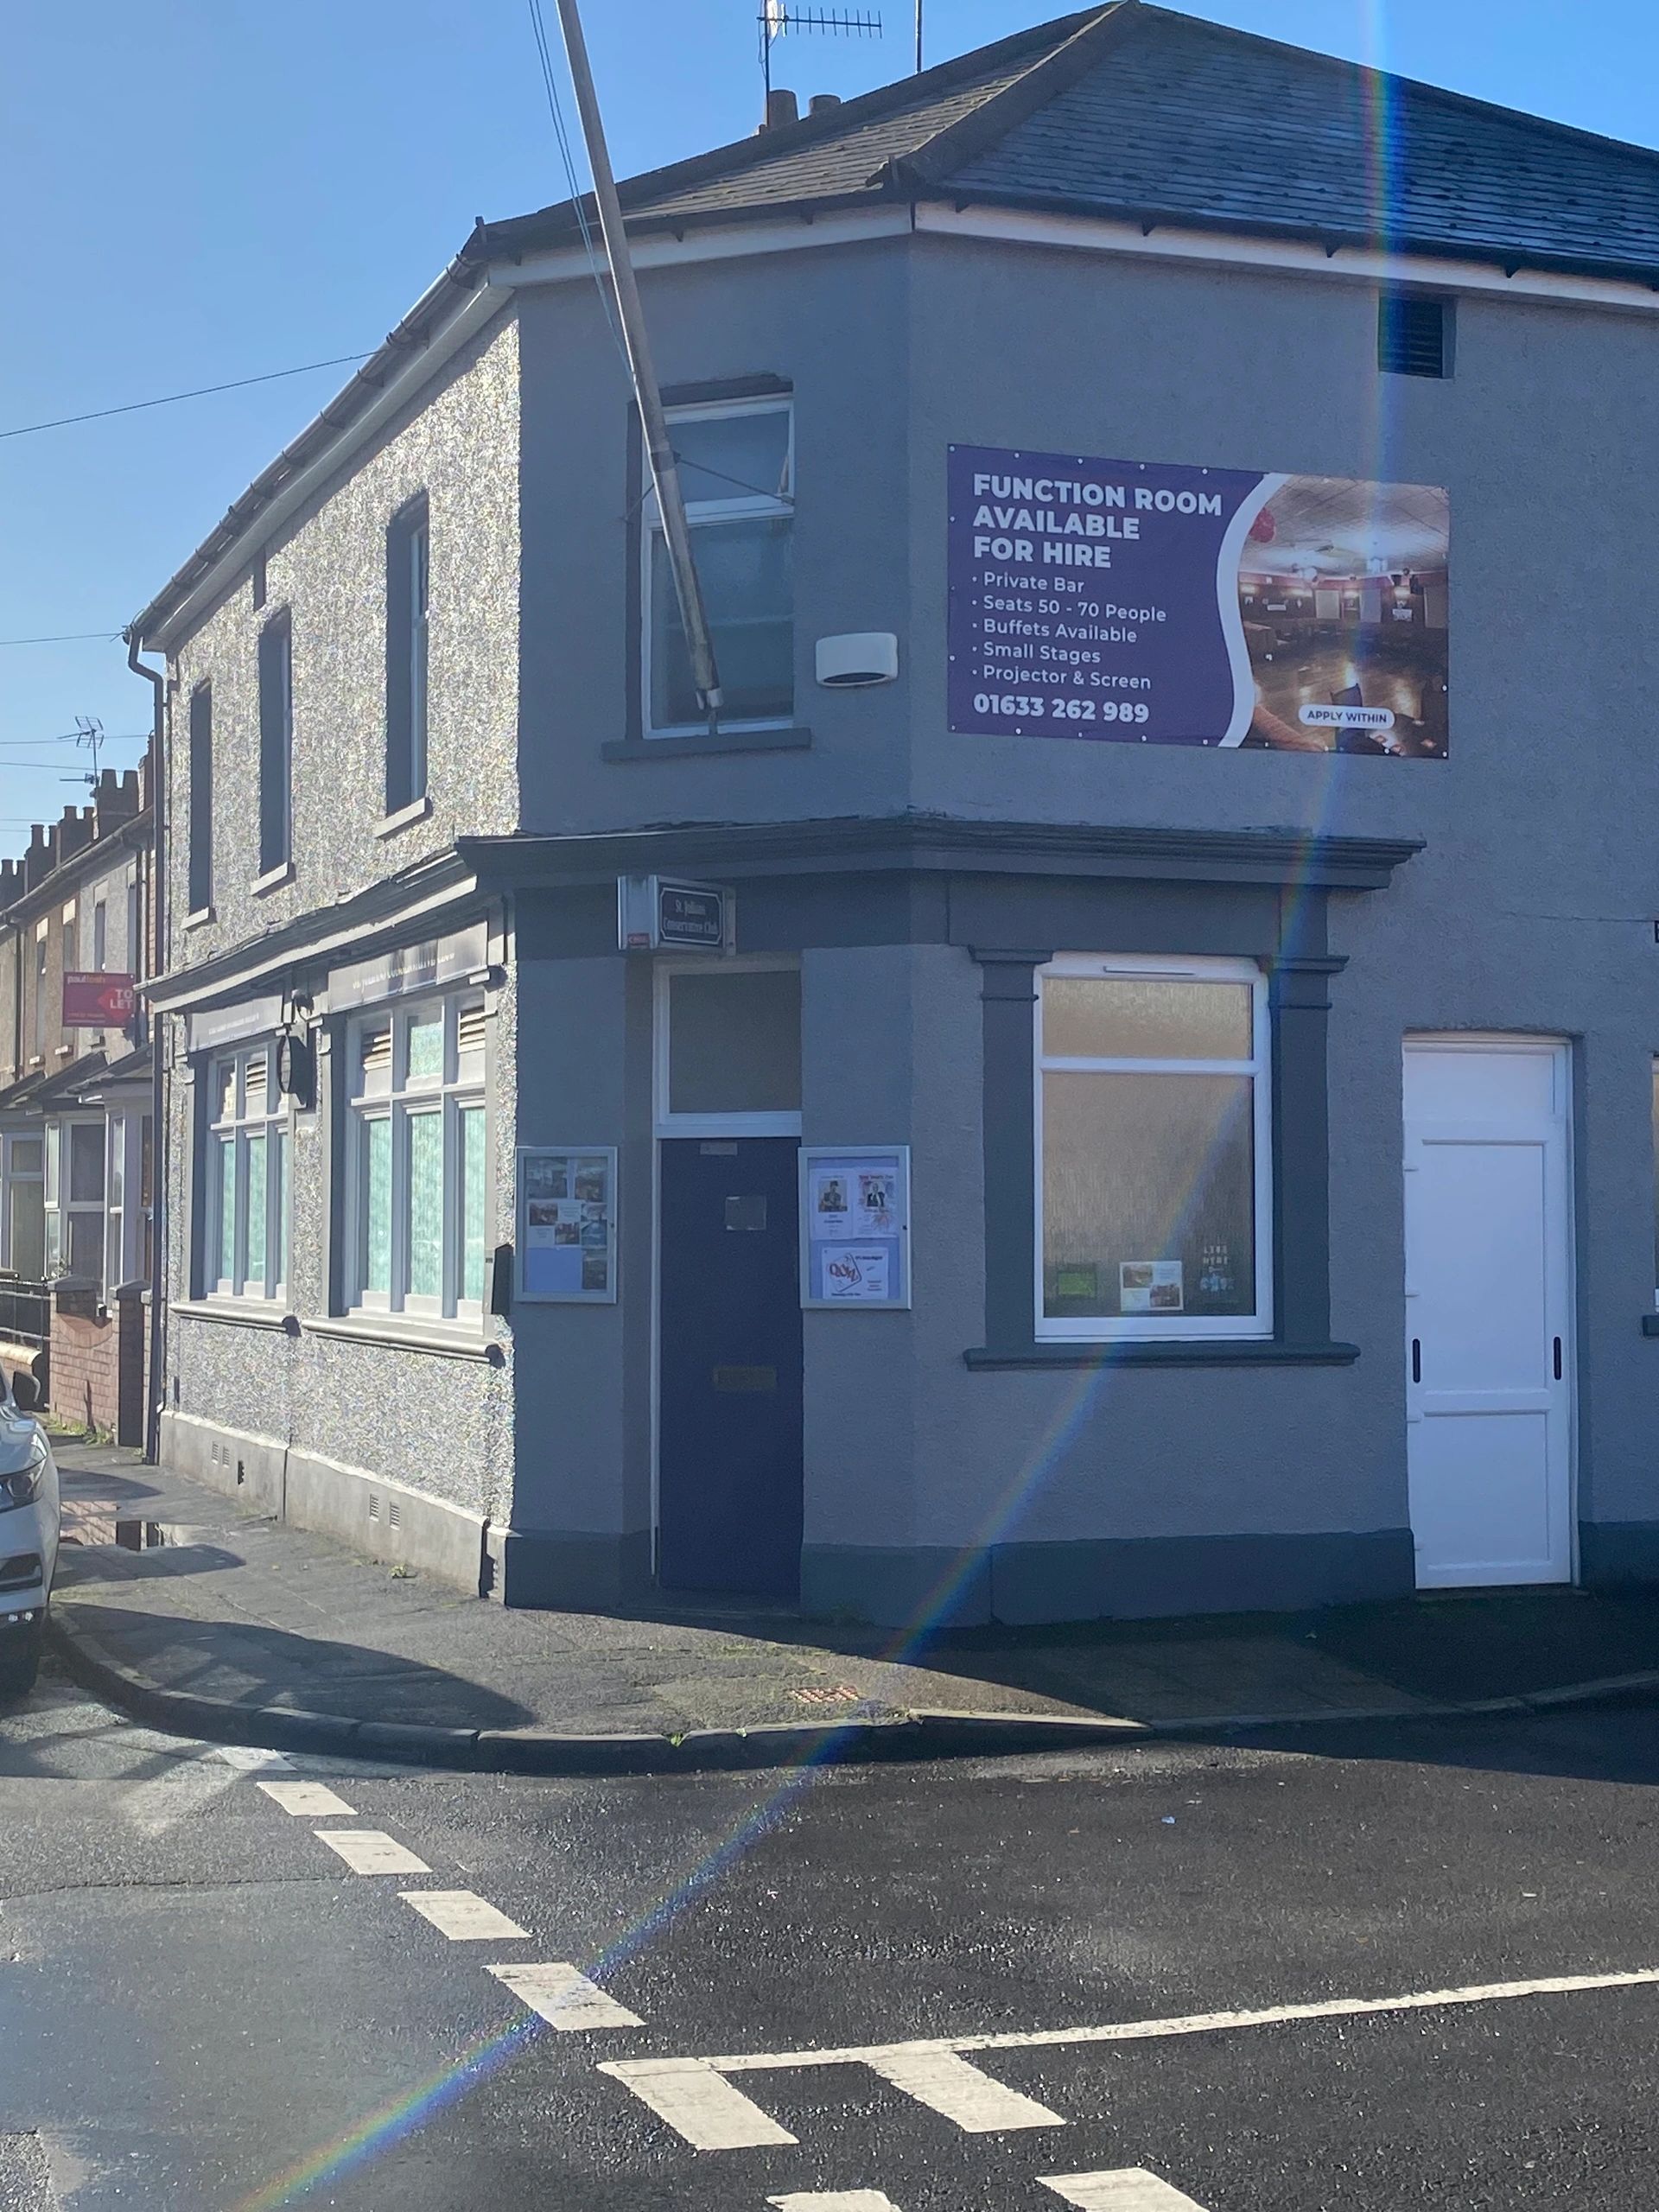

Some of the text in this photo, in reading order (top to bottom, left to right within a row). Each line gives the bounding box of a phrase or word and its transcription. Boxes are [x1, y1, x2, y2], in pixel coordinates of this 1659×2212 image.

[973, 474, 1222, 516] FUNCTION ROOM
[973, 505, 1141, 539] AVAILABLE
[973, 536, 1111, 569] FOR HIRE
[983, 571, 1084, 594] Private Bar
[983, 595, 1033, 613] Seats
[1039, 599, 1060, 614] 50
[1077, 601, 1099, 618] 70
[1105, 604, 1166, 624] People
[983, 619, 1137, 643] Buffets Available
[983, 642, 1101, 665] Small Stages
[983, 664, 1152, 690] Projector & Screen
[973, 693, 1150, 723] 01633 262 989
[1306, 709, 1388, 723] APPLY WITHIN
[110, 1000, 133, 1009] LET
[115, 989, 132, 999] TO
